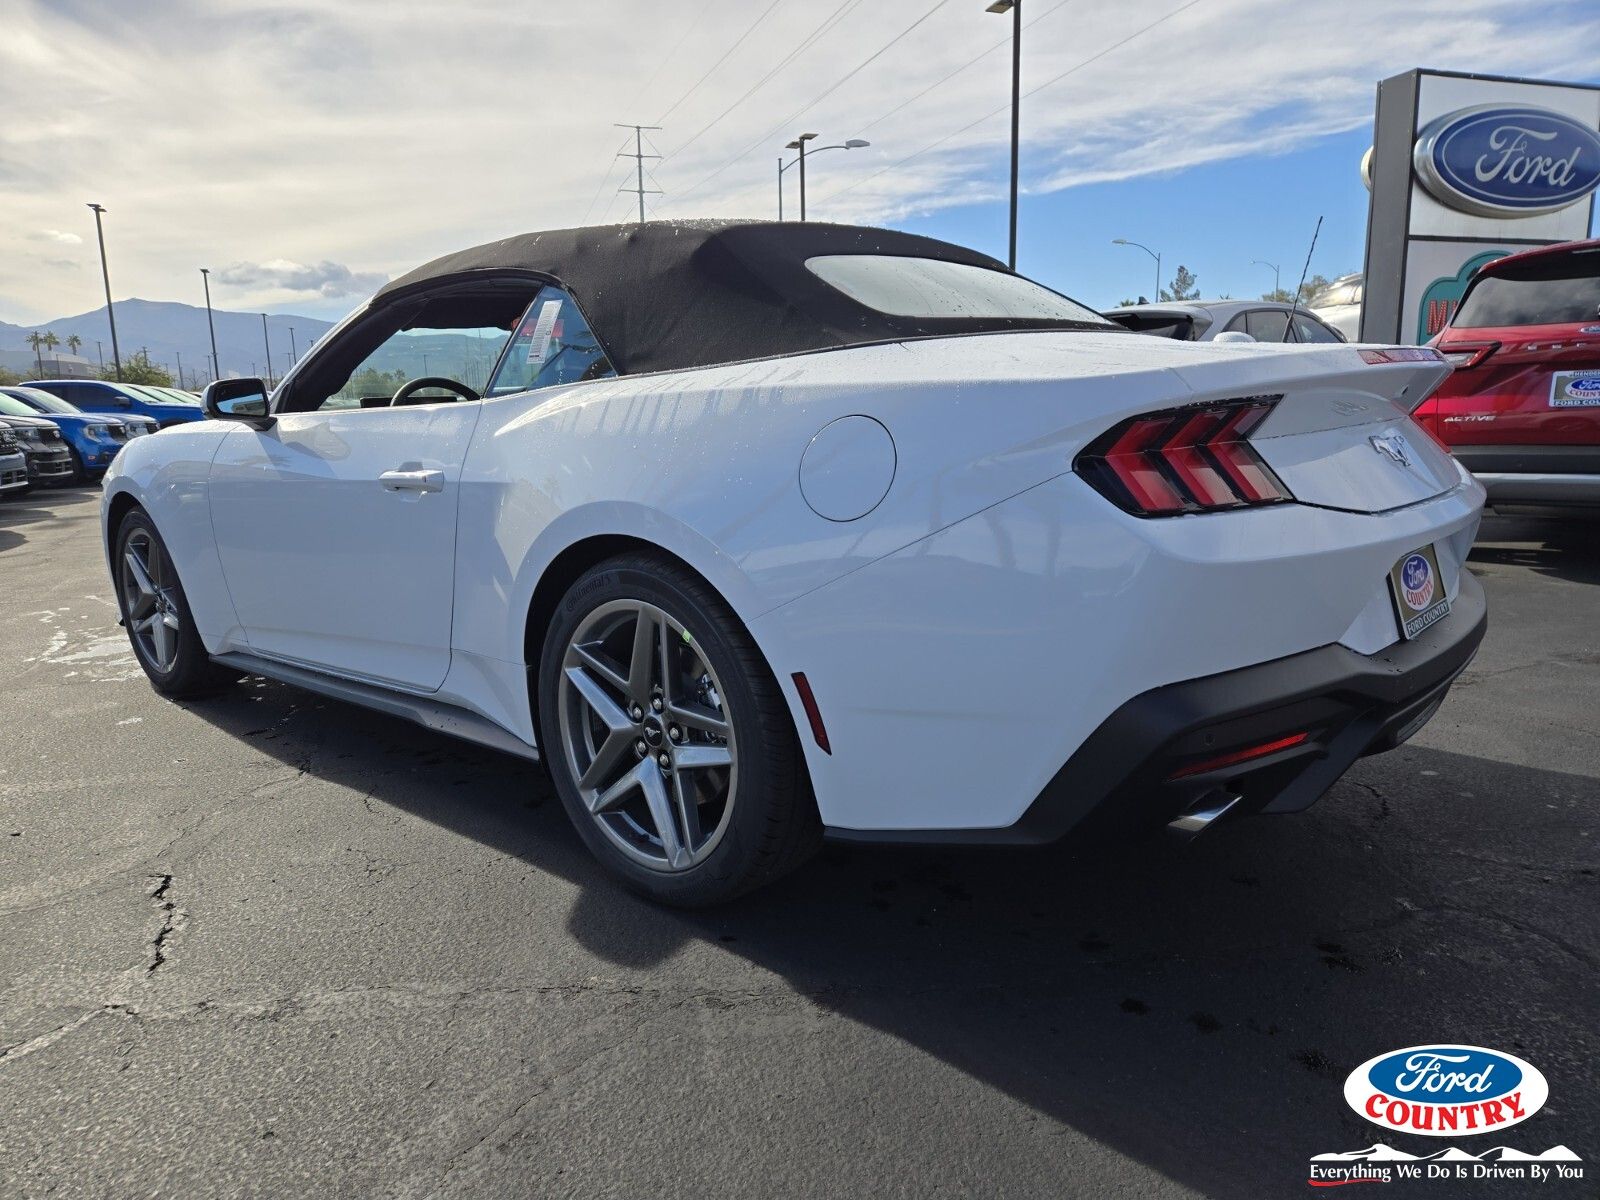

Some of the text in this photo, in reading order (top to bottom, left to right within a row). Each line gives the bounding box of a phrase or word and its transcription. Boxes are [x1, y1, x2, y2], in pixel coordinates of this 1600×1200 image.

[1475, 125, 1582, 187] Ford
[1443, 415, 1496, 423] ACTIVE
[1408, 560, 1426, 587] Ford
[1406, 576, 1434, 605] COUNTRY
[1407, 602, 1449, 635] FORD COUNTRY
